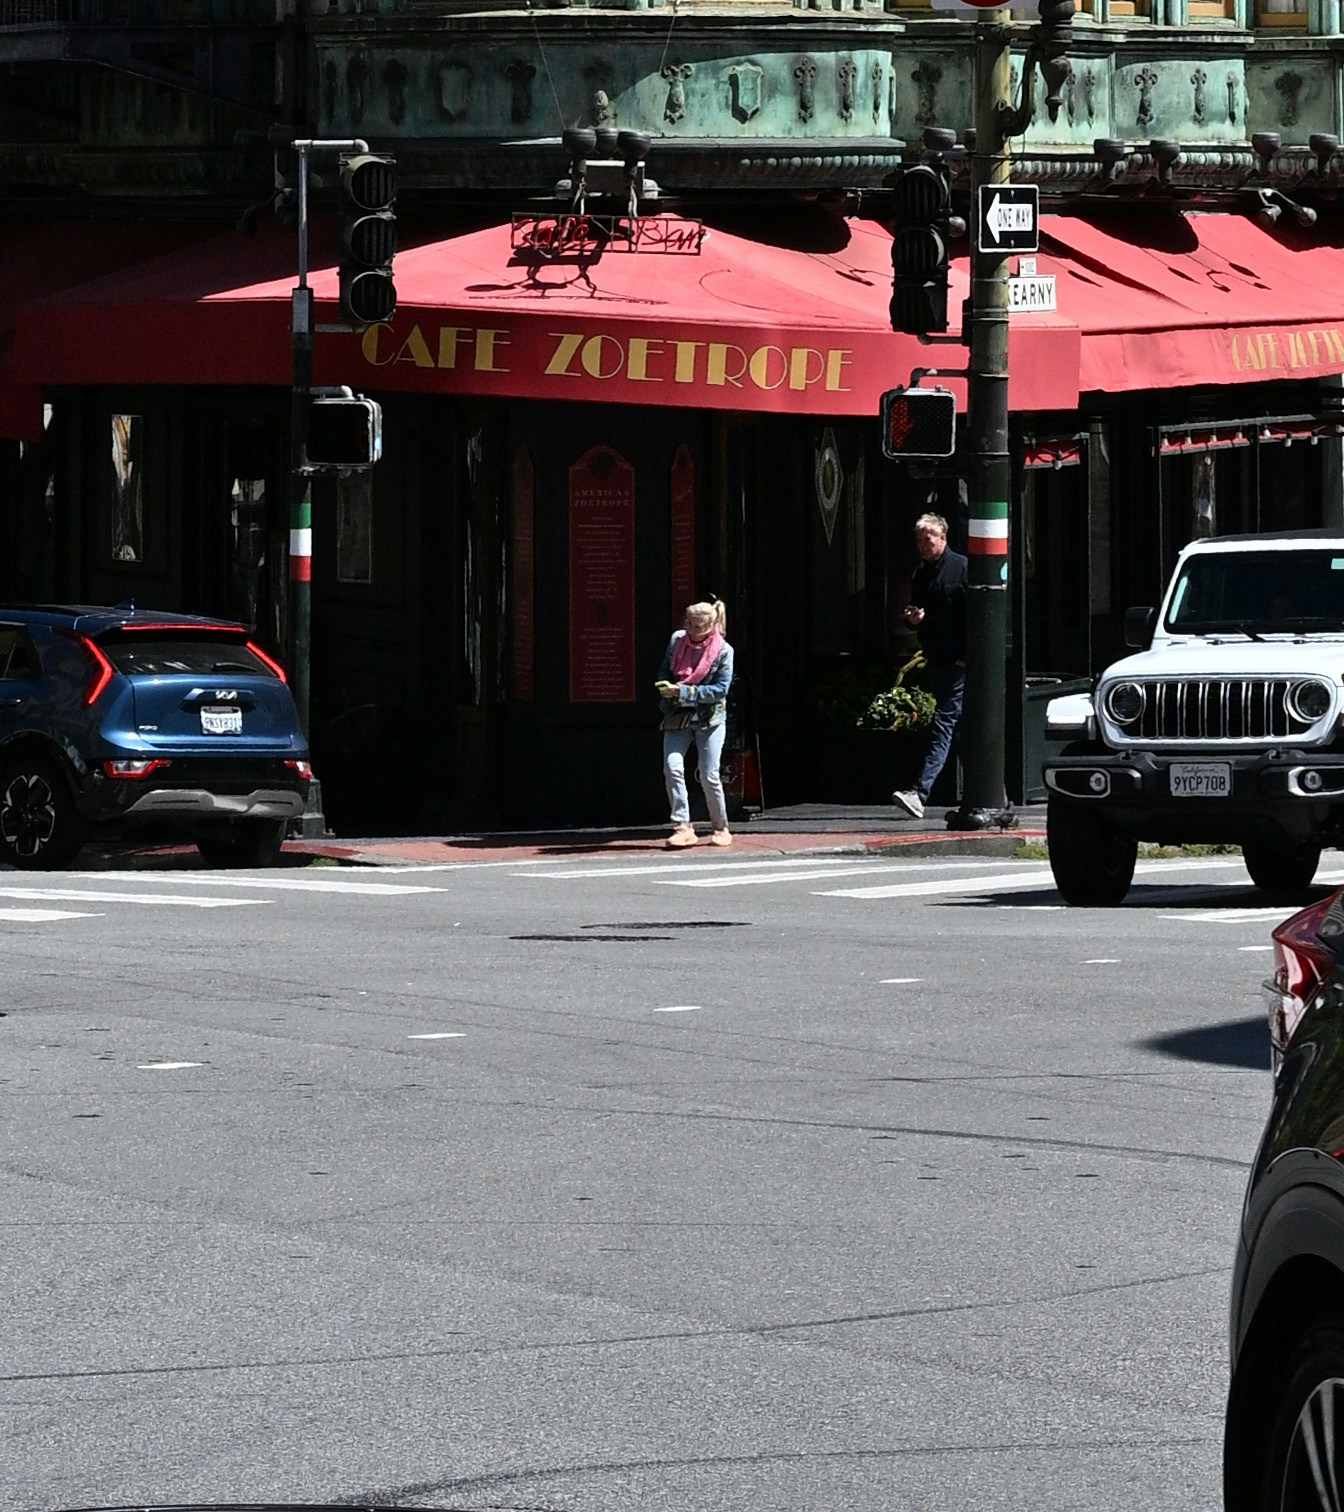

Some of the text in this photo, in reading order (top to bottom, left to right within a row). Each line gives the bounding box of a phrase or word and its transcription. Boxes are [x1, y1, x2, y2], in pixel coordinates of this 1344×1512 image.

[997, 208, 1031, 228] ONE WAY
[361, 322, 854, 392] CAFE ZOETROPE
[1231, 332, 1281, 372] CAFE
[1173, 776, 1226, 792] 9YCP708
